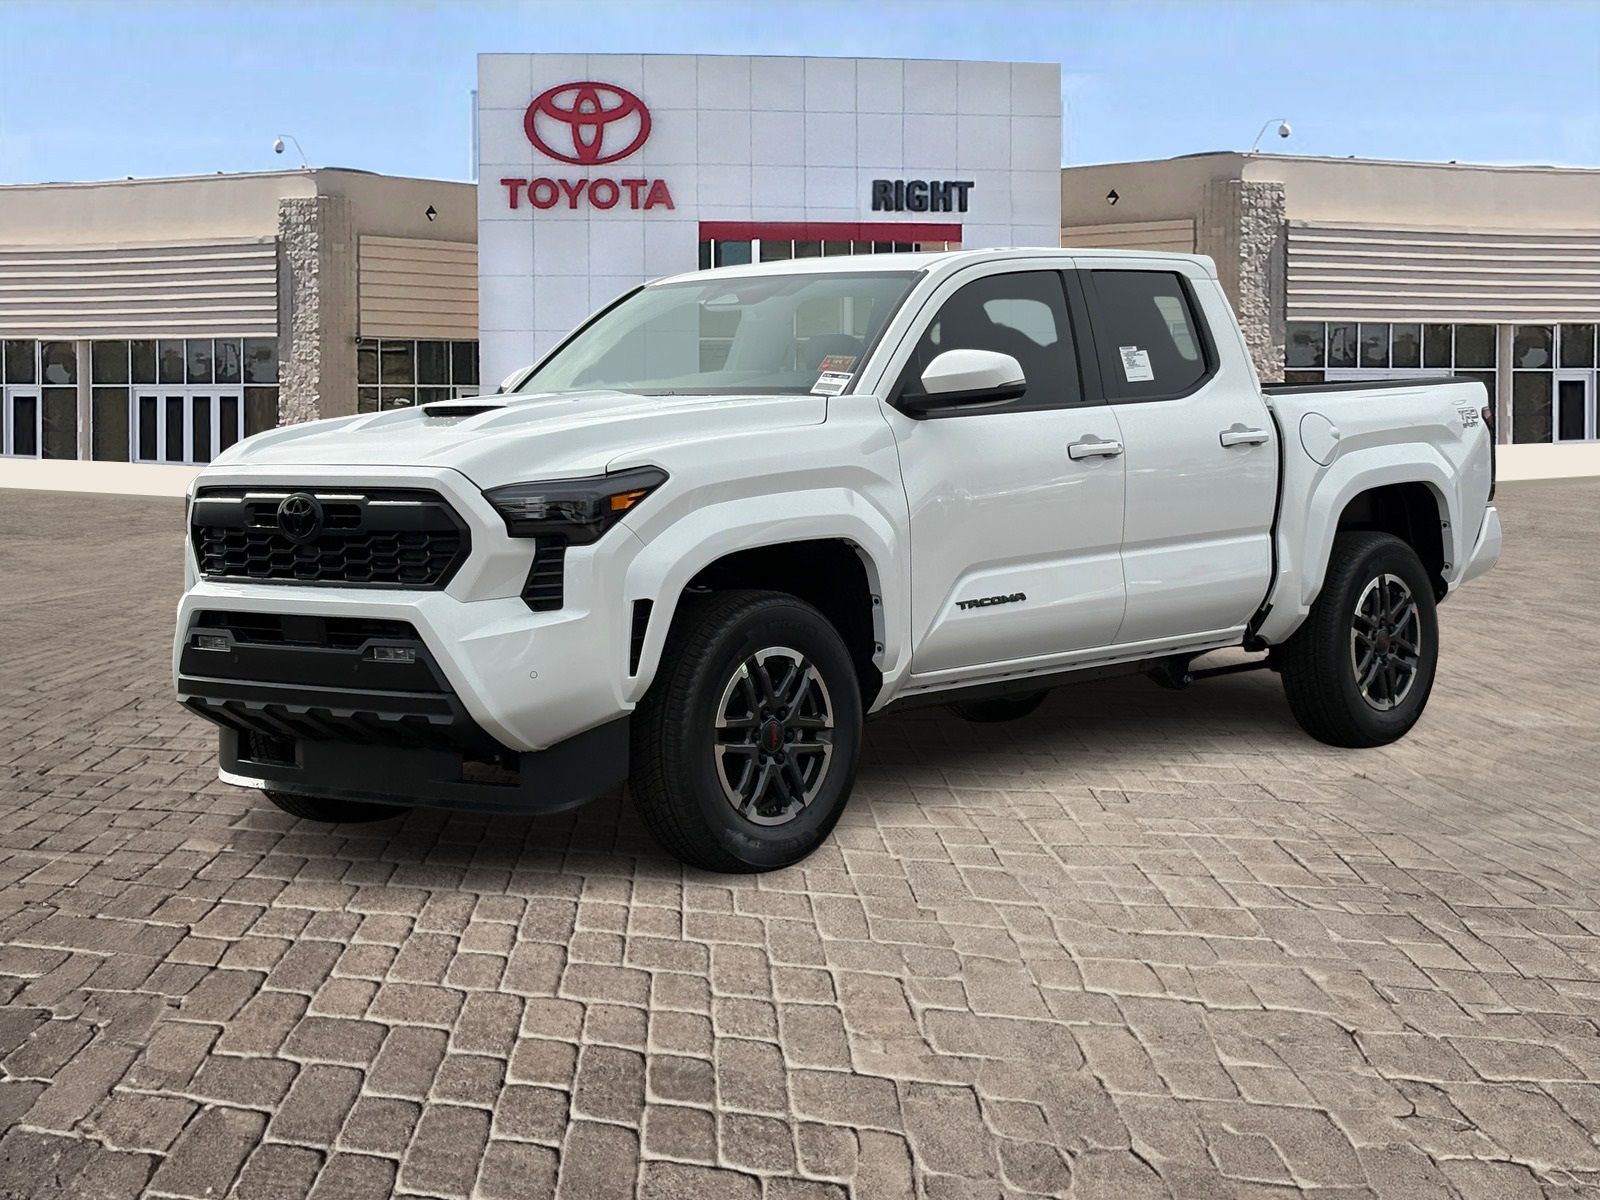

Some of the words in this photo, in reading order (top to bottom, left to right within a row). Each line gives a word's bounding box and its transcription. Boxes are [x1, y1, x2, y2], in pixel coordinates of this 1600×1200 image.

[500, 177, 676, 210] TOYOTA
[871, 179, 975, 212] RIGHT
[1457, 406, 1479, 421] TRD
[955, 592, 1027, 610] TACOMA
